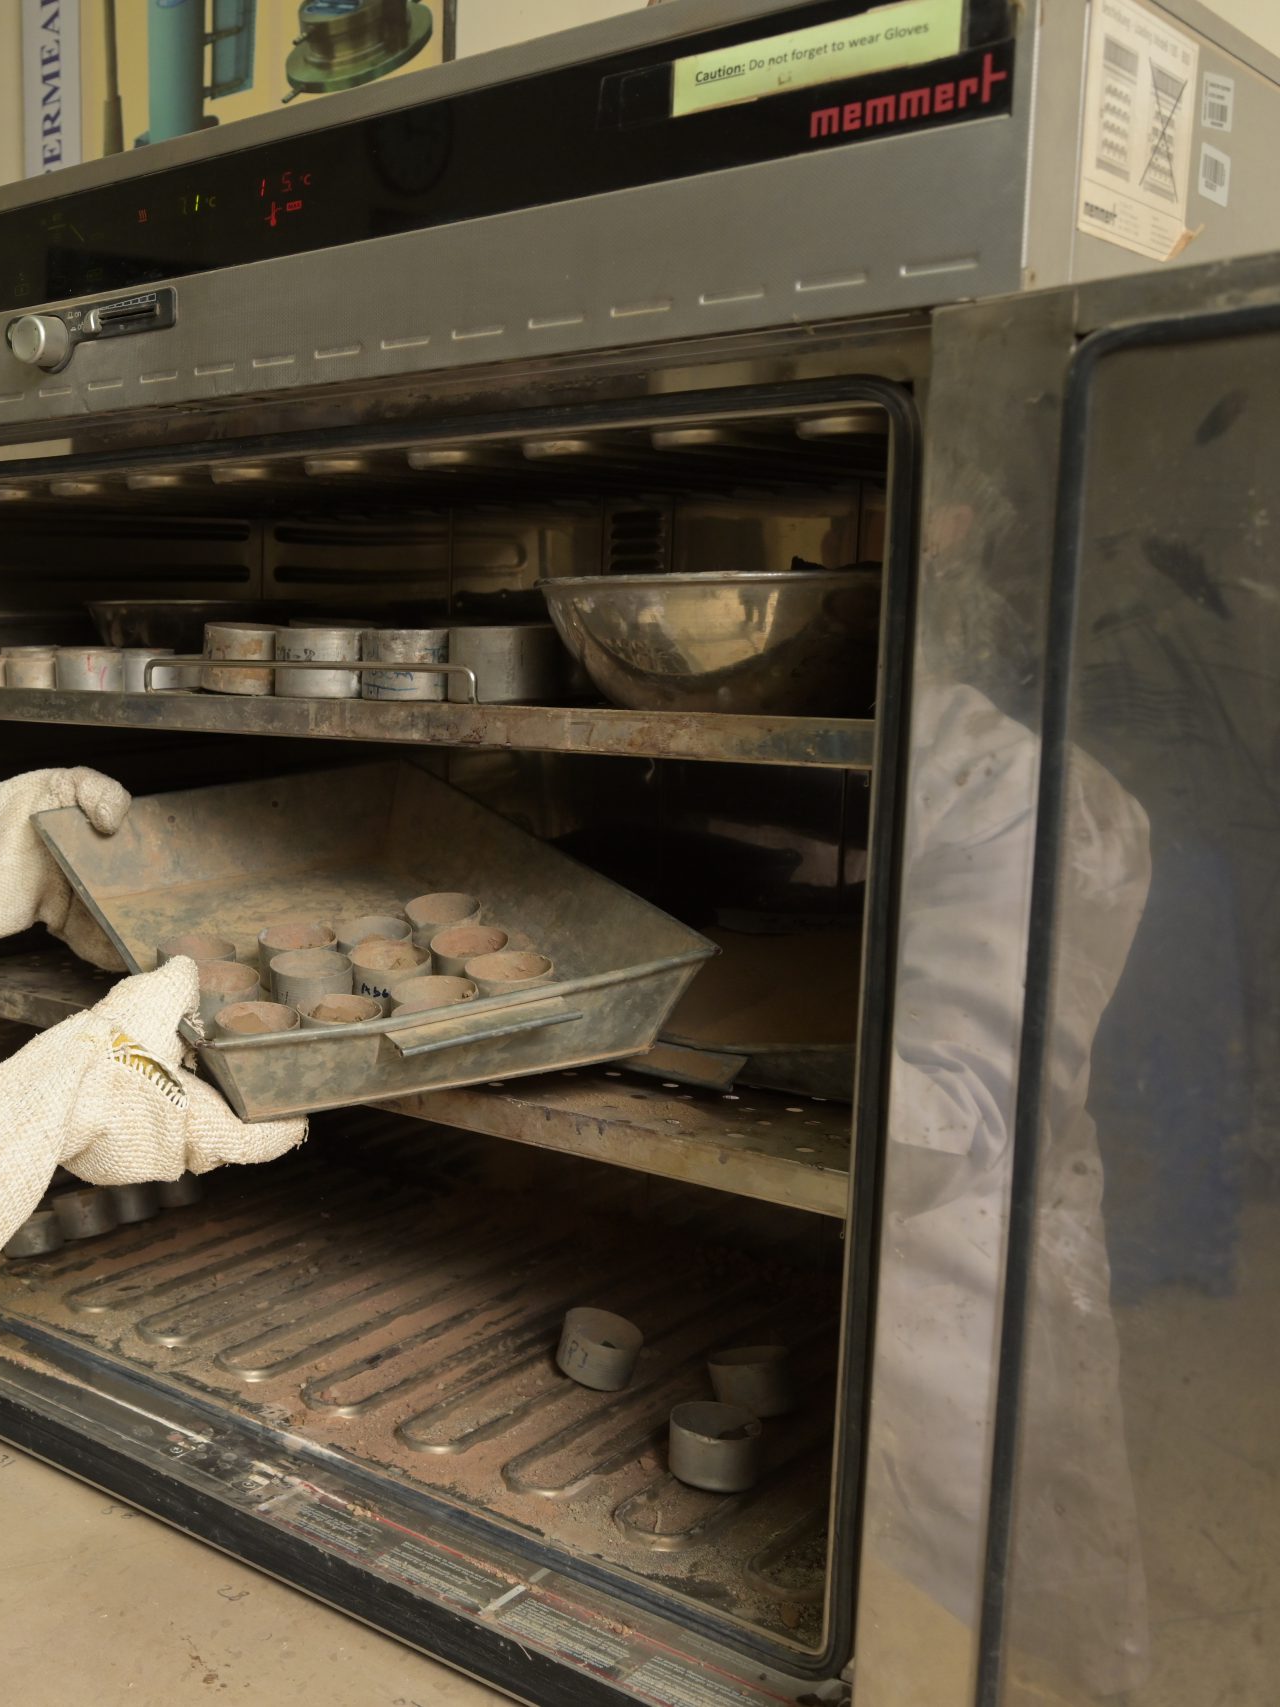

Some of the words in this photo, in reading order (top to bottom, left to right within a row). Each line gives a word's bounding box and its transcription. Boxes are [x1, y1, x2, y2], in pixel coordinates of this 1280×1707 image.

[40, 0, 62, 174] ERMEA
[695, 62, 746, 86] Caution:
[748, 58, 765, 71] Do
[768, 52, 788, 67] not
[791, 43, 829, 61] forget
[832, 38, 845, 52] to
[848, 33, 881, 49] wear
[884, 22, 930, 41] Gloves
[810, 53, 1007, 138] memmert
